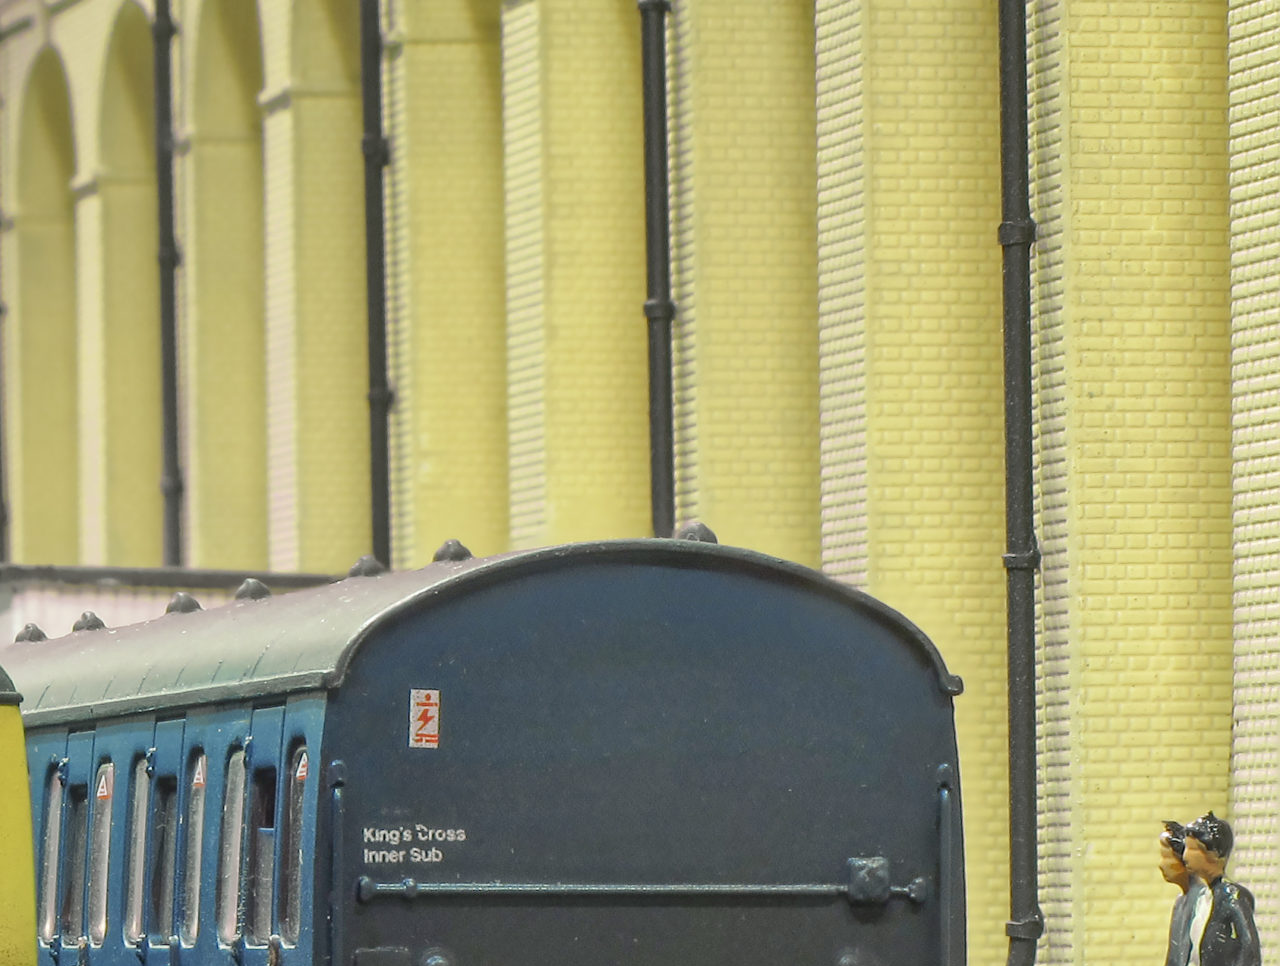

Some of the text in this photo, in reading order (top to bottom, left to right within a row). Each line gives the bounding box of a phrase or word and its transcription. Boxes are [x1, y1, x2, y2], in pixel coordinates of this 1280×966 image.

[363, 824, 466, 845] King's Cross
[363, 847, 443, 863] Inner Sub
